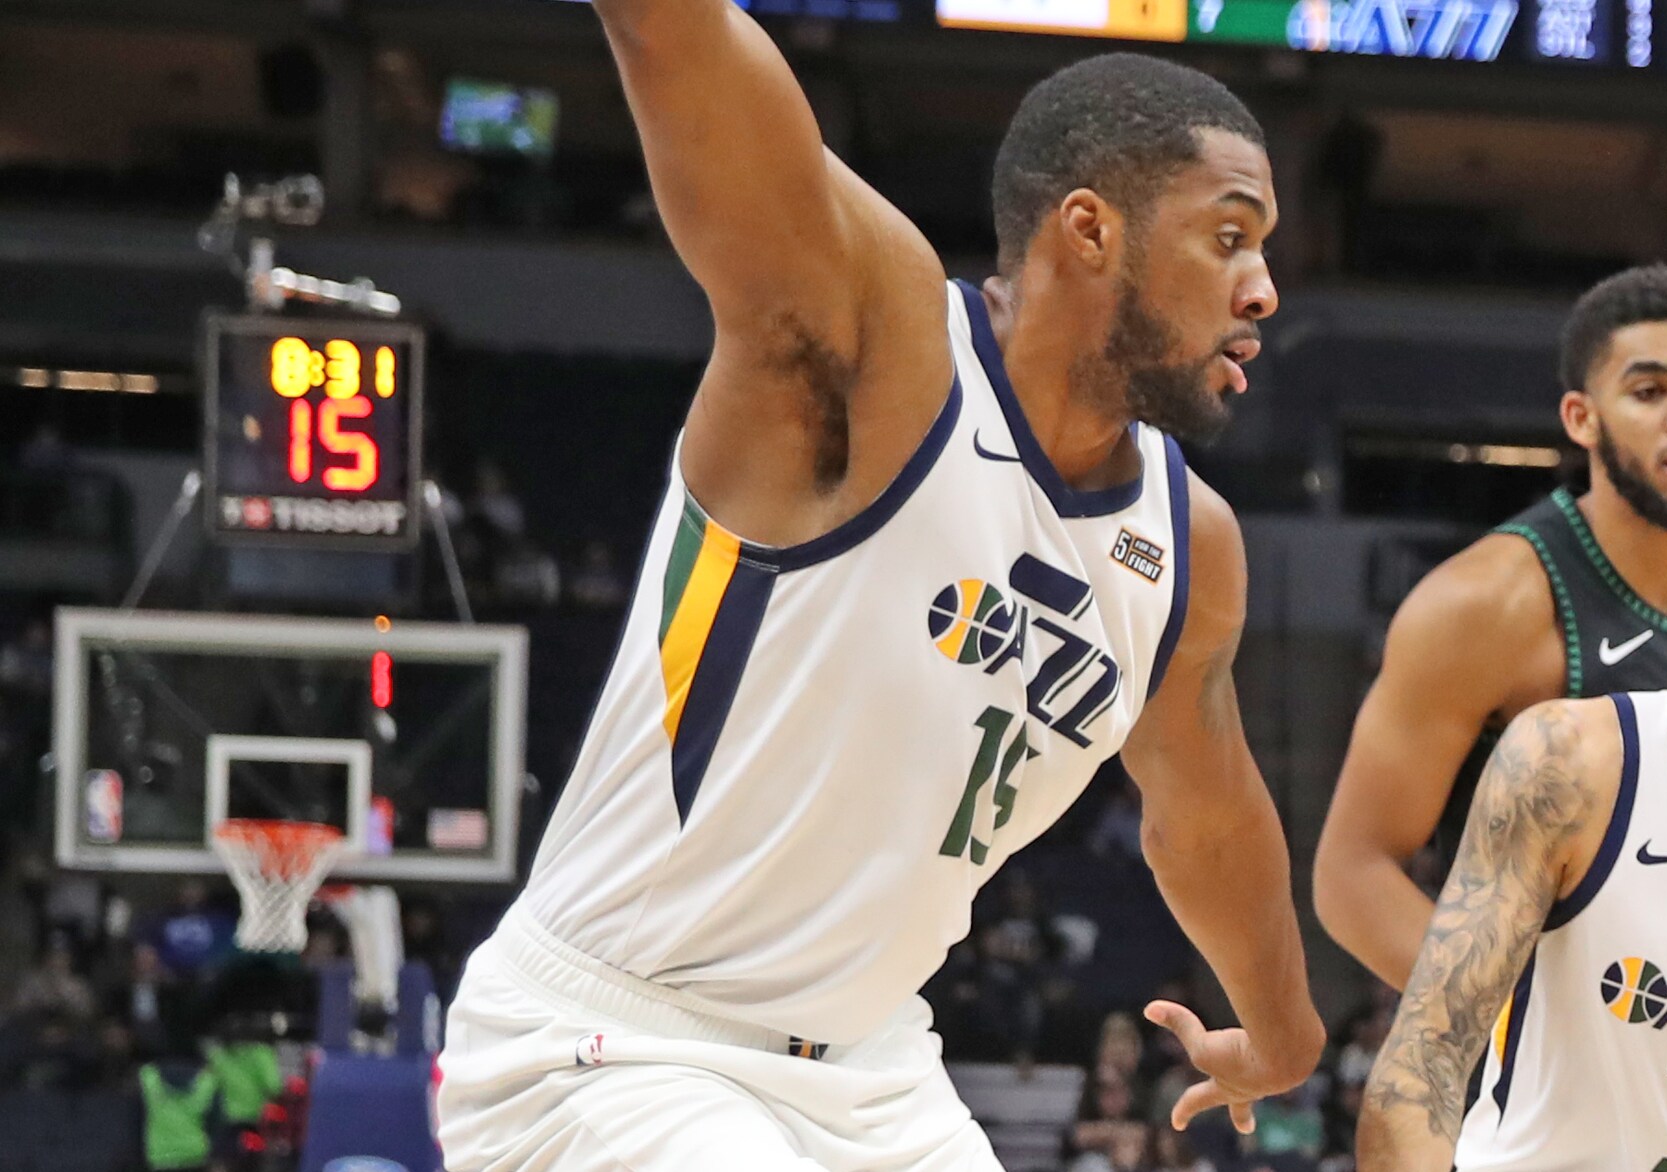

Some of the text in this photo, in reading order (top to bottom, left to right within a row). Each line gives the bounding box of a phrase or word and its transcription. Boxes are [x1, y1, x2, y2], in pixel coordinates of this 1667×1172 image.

[271, 336, 396, 398] 8:31
[288, 395, 379, 491] 15
[273, 497, 405, 535] TISSOT
[1114, 532, 1131, 560] 5
[1128, 553, 1161, 579] FIGHT
